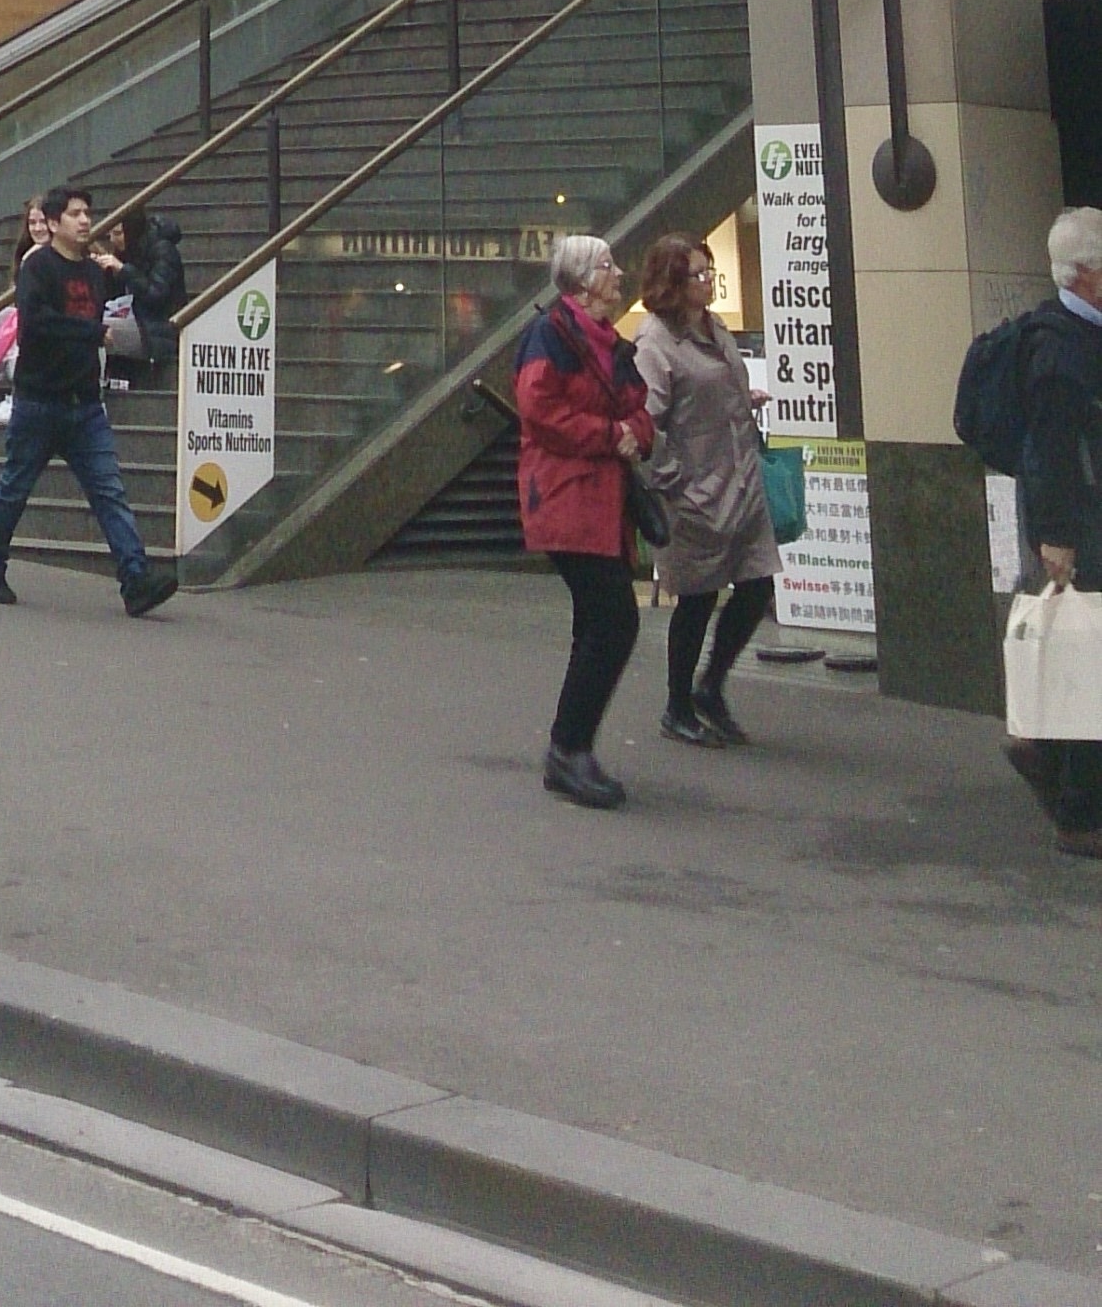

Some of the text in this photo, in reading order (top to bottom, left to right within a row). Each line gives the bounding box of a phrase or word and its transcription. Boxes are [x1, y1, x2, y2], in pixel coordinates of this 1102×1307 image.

[795, 160, 824, 176] NUT
[762, 191, 794, 206] Walk
[796, 212, 817, 227] for
[785, 230, 827, 256] larg
[787, 259, 829, 275] range
[191, 343, 271, 371] EVELYN FAYE
[196, 370, 265, 397] NUTRITION
[777, 354, 835, 391] & sp
[207, 407, 254, 429] Vitamins
[187, 430, 272, 455] Sports Nutrition
